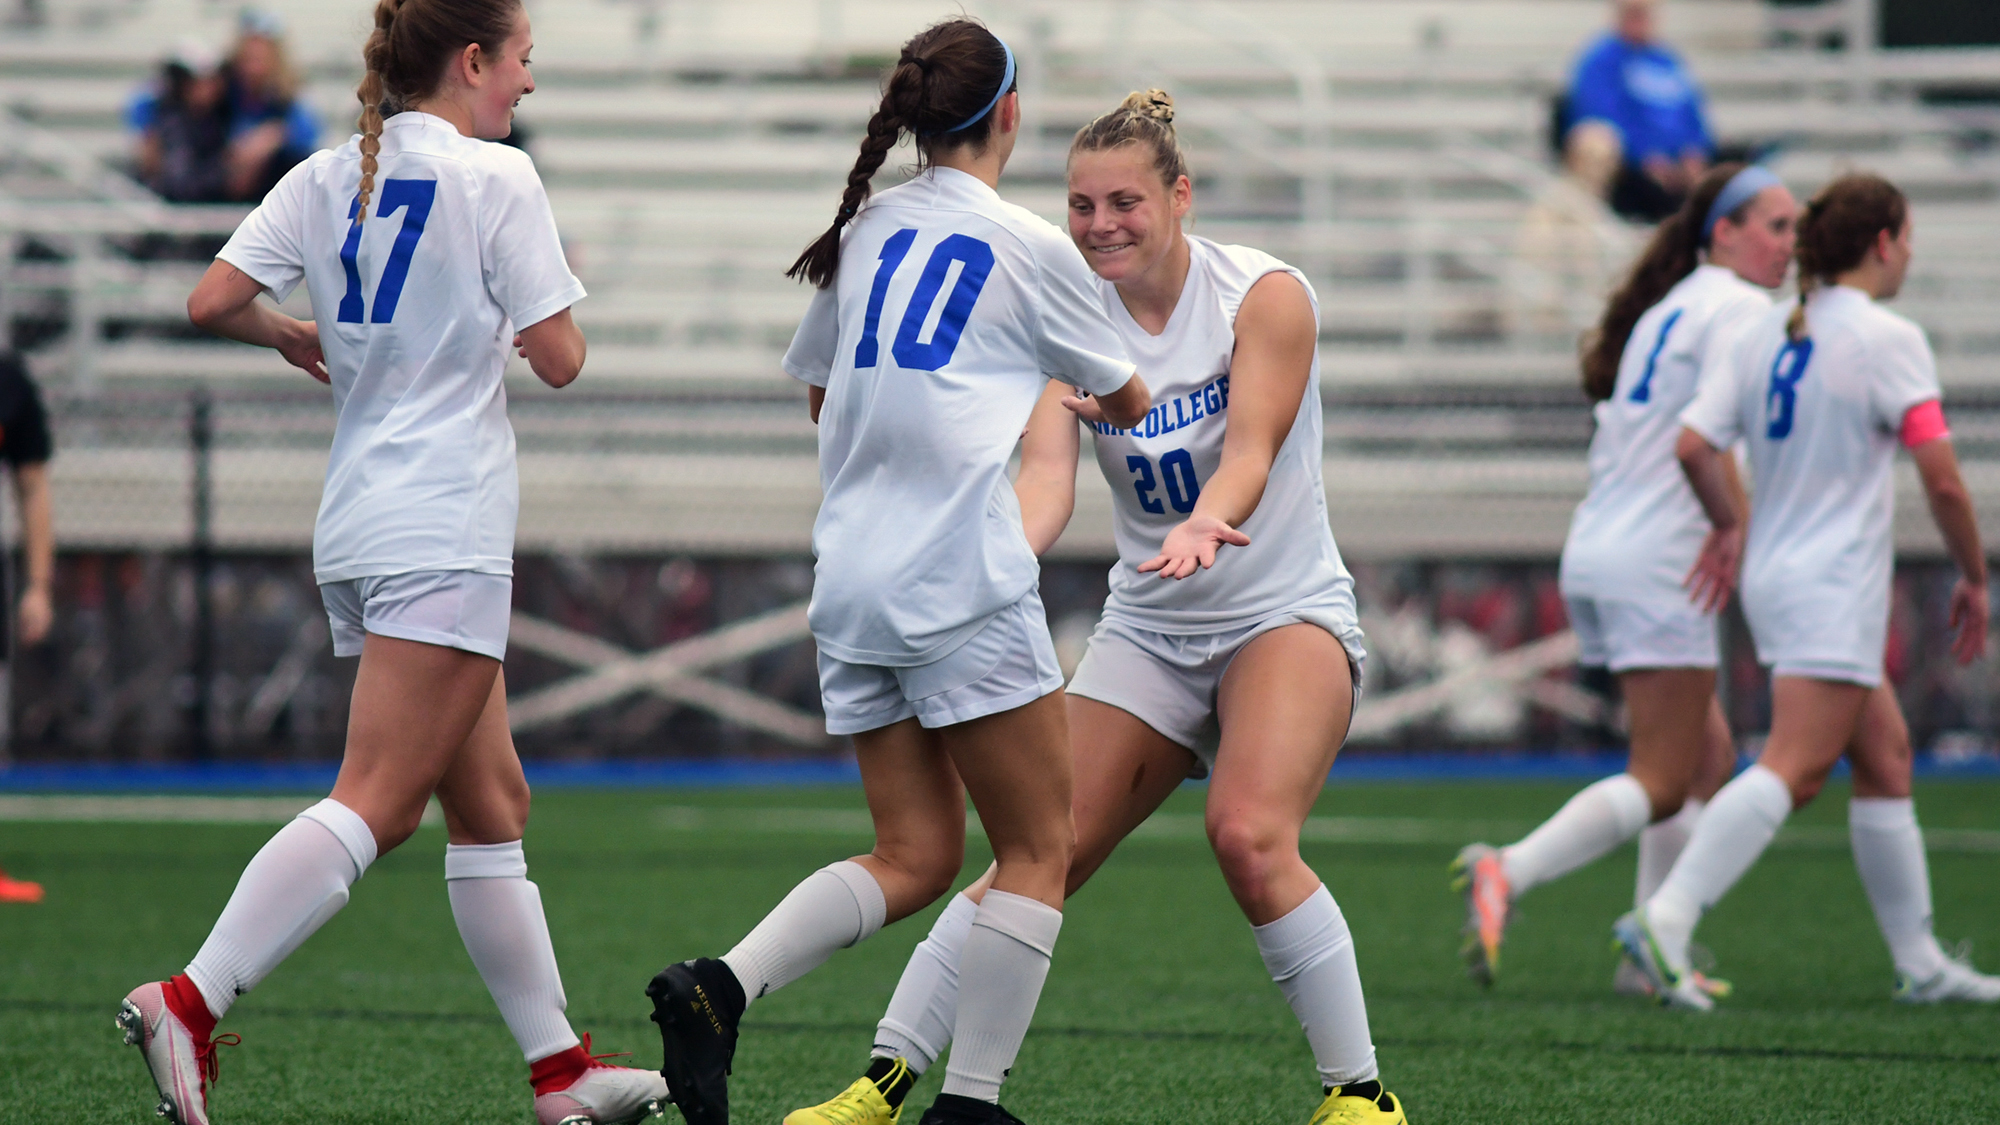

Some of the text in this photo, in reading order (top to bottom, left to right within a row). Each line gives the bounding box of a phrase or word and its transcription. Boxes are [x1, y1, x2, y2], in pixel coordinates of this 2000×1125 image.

[337, 178, 437, 324] 17
[854, 228, 995, 372] 10
[1628, 308, 1684, 403] 1
[1766, 335, 1815, 439] 8
[1126, 448, 1200, 514] 20
